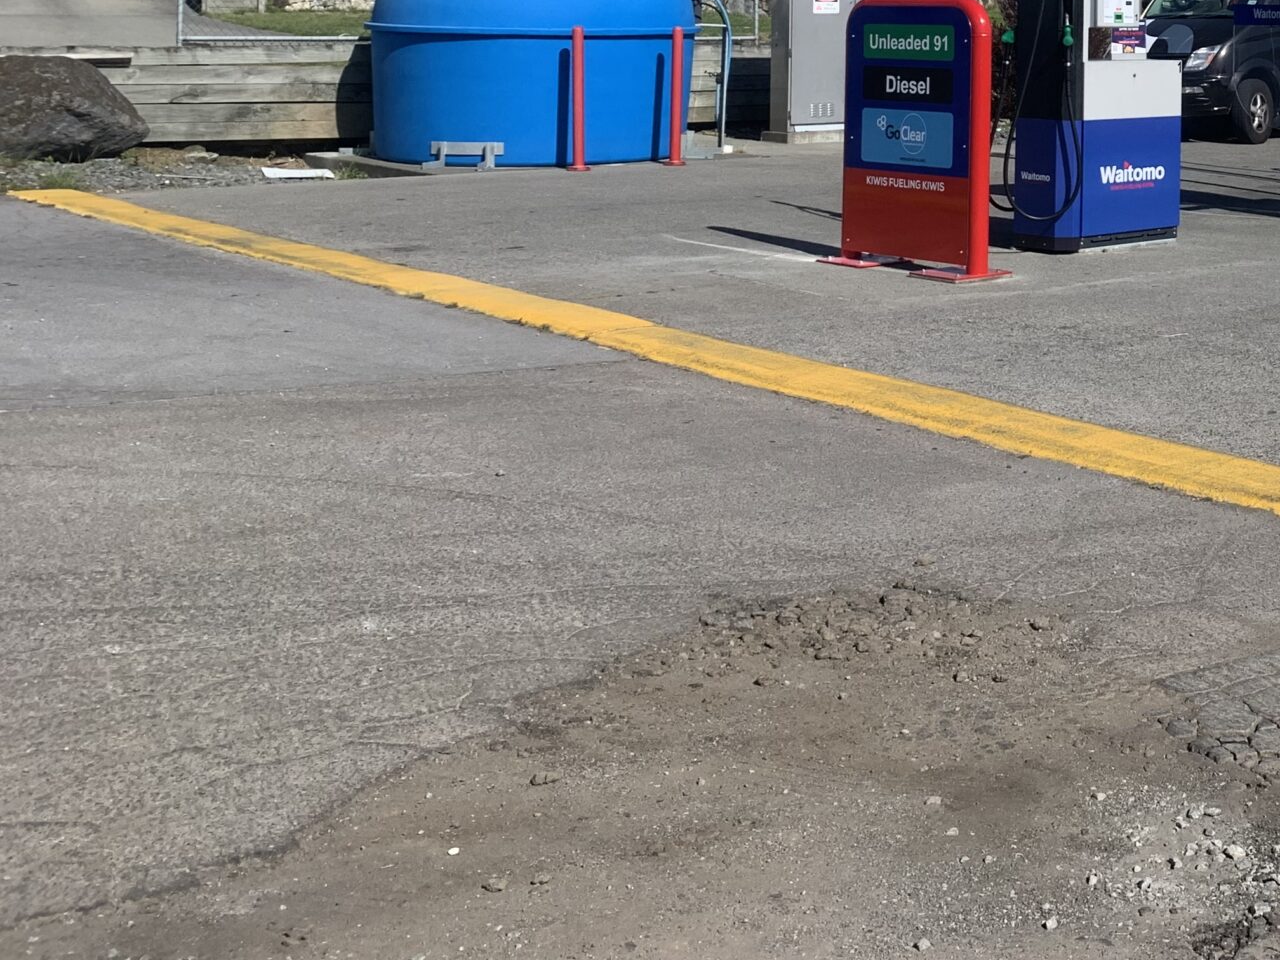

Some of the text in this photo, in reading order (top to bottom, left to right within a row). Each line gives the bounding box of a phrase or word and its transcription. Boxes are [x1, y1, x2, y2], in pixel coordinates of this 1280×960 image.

[869, 33, 949, 51] Unleaded 91
[885, 74, 930, 95] Diesel
[866, 174, 945, 192] KIWIS FUELING KIWIS
[1020, 170, 1051, 183] Waitomo
[1100, 164, 1166, 185] Waitomo
